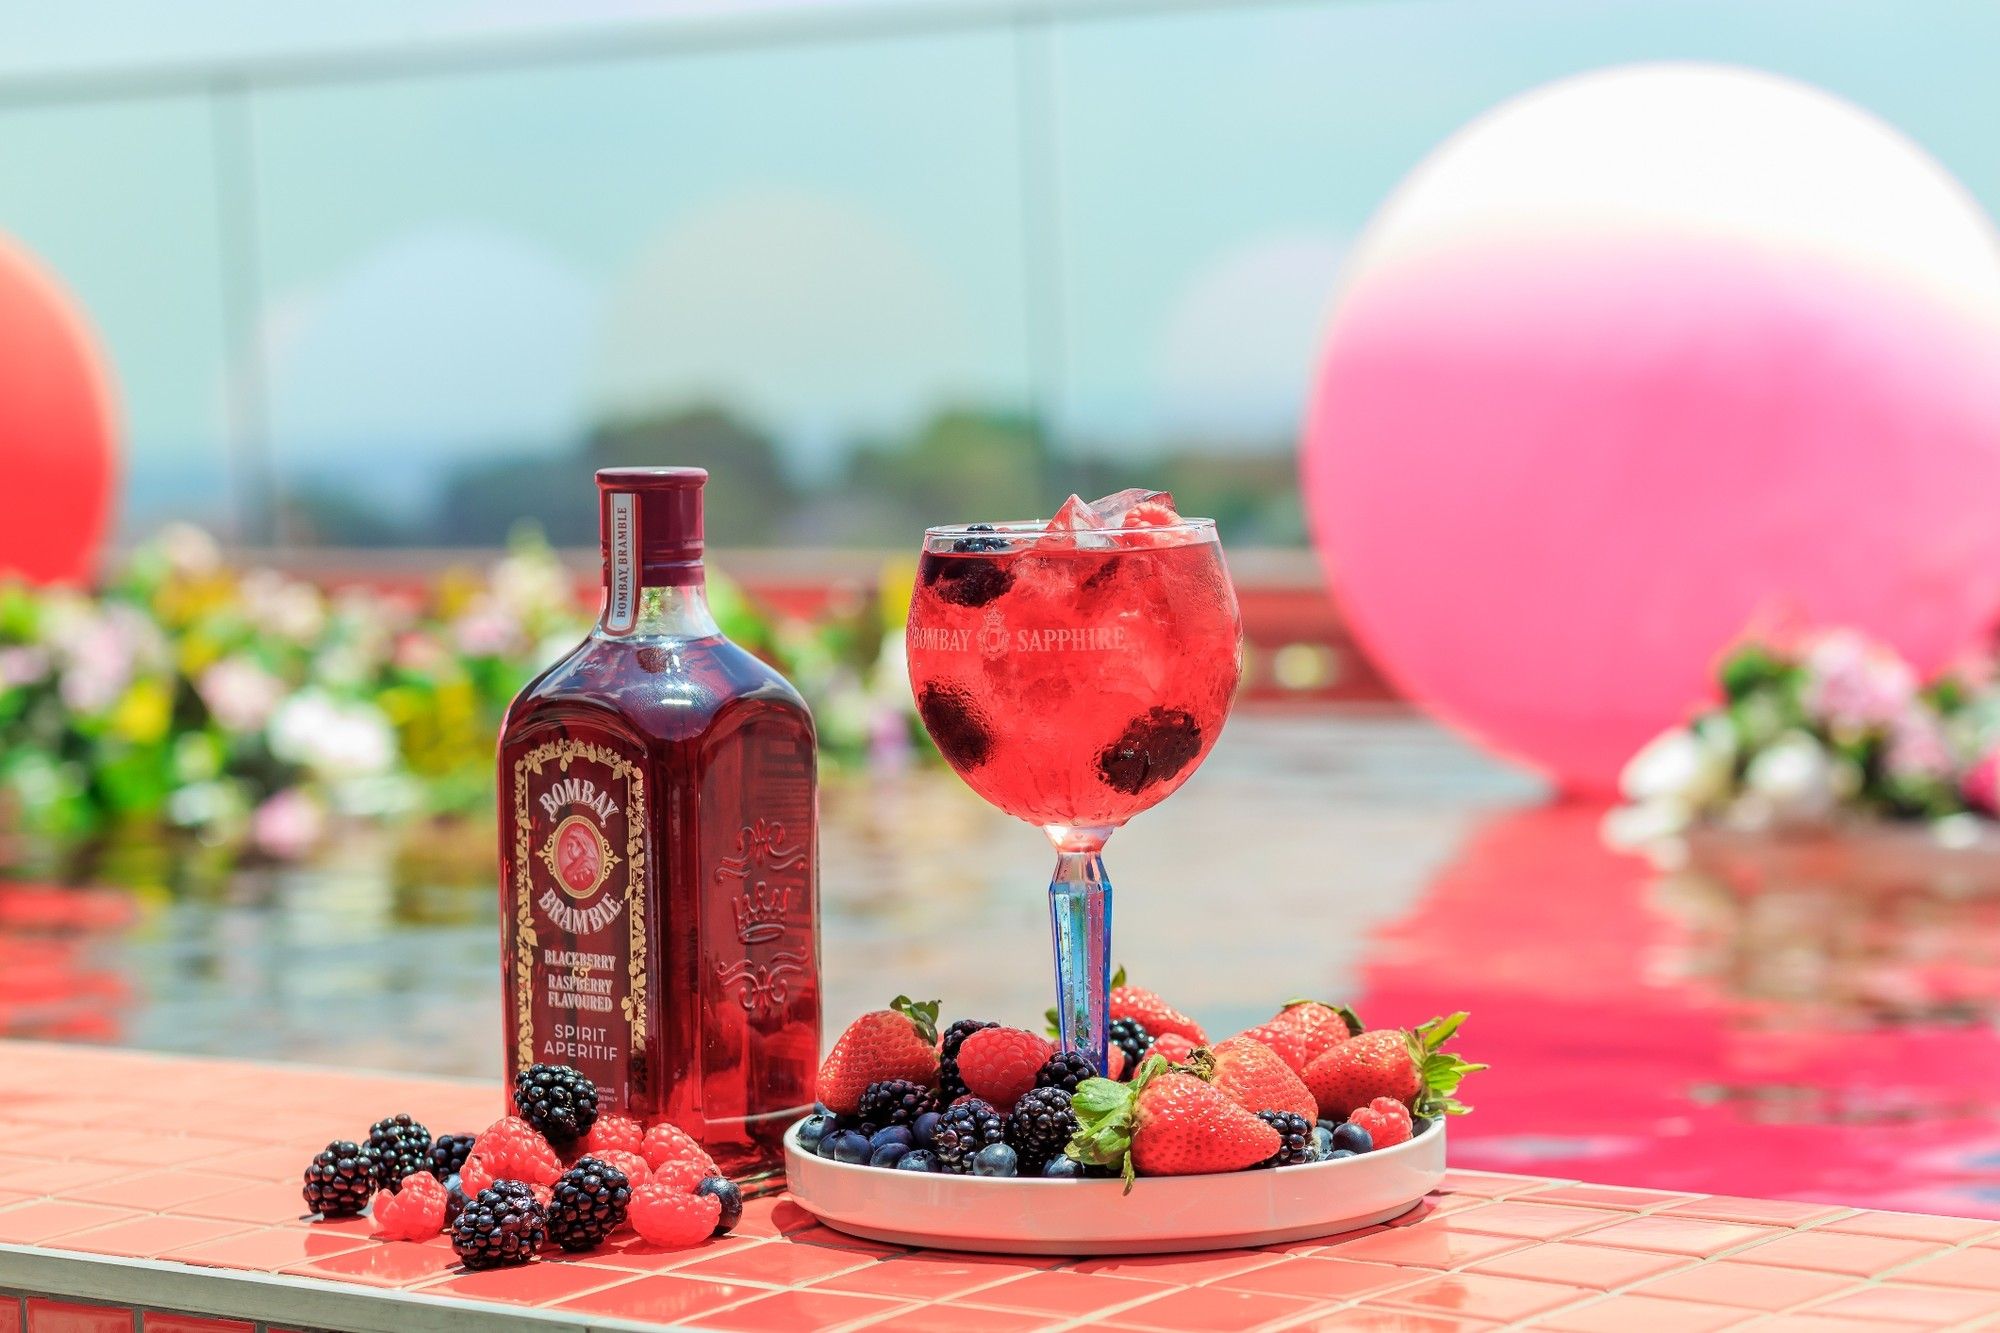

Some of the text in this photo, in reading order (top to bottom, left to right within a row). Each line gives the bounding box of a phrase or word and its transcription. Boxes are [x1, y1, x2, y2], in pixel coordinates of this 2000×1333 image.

[617, 507, 628, 566] BRAMBLE
[912, 626, 1128, 652] BOMBAY SAPPHIRE
[539, 778, 619, 828] BOMBAY
[544, 949, 616, 971] BLACKBERRY
[548, 974, 613, 996] RASPBERRY
[548, 991, 613, 1013] FLAVOURED
[555, 1024, 606, 1042] SPIRIT
[544, 1040, 618, 1061] APERITIF
